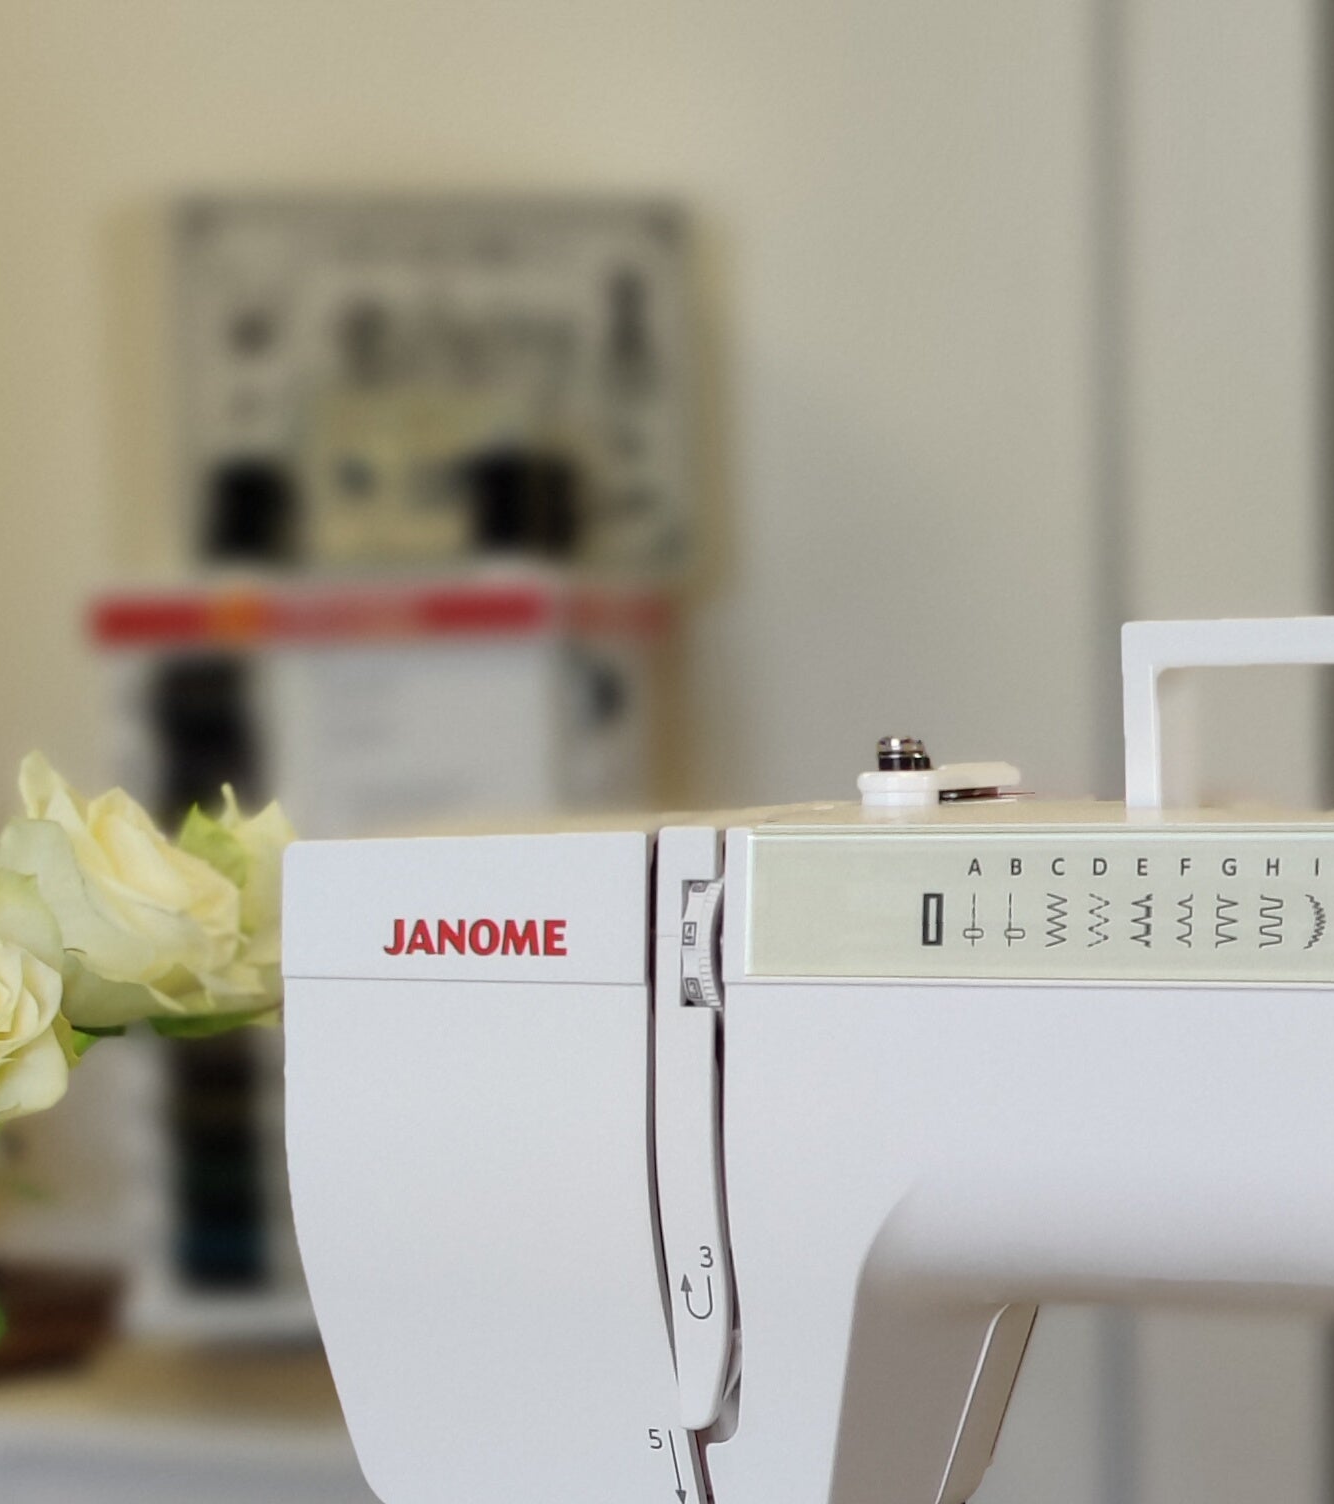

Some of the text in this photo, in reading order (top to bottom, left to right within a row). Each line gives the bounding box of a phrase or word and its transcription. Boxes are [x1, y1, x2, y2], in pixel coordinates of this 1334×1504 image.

[967, 858, 982, 876] A
[1010, 858, 1022, 876] B
[1051, 857, 1065, 876] C
[1092, 857, 1108, 876] D
[1137, 858, 1148, 876] E
[1180, 857, 1191, 876] F
[1221, 857, 1237, 877] G
[1266, 858, 1280, 876] H
[383, 919, 567, 956] JANOME
[699, 1245, 714, 1269] 3
[648, 1428, 663, 1450] 5
